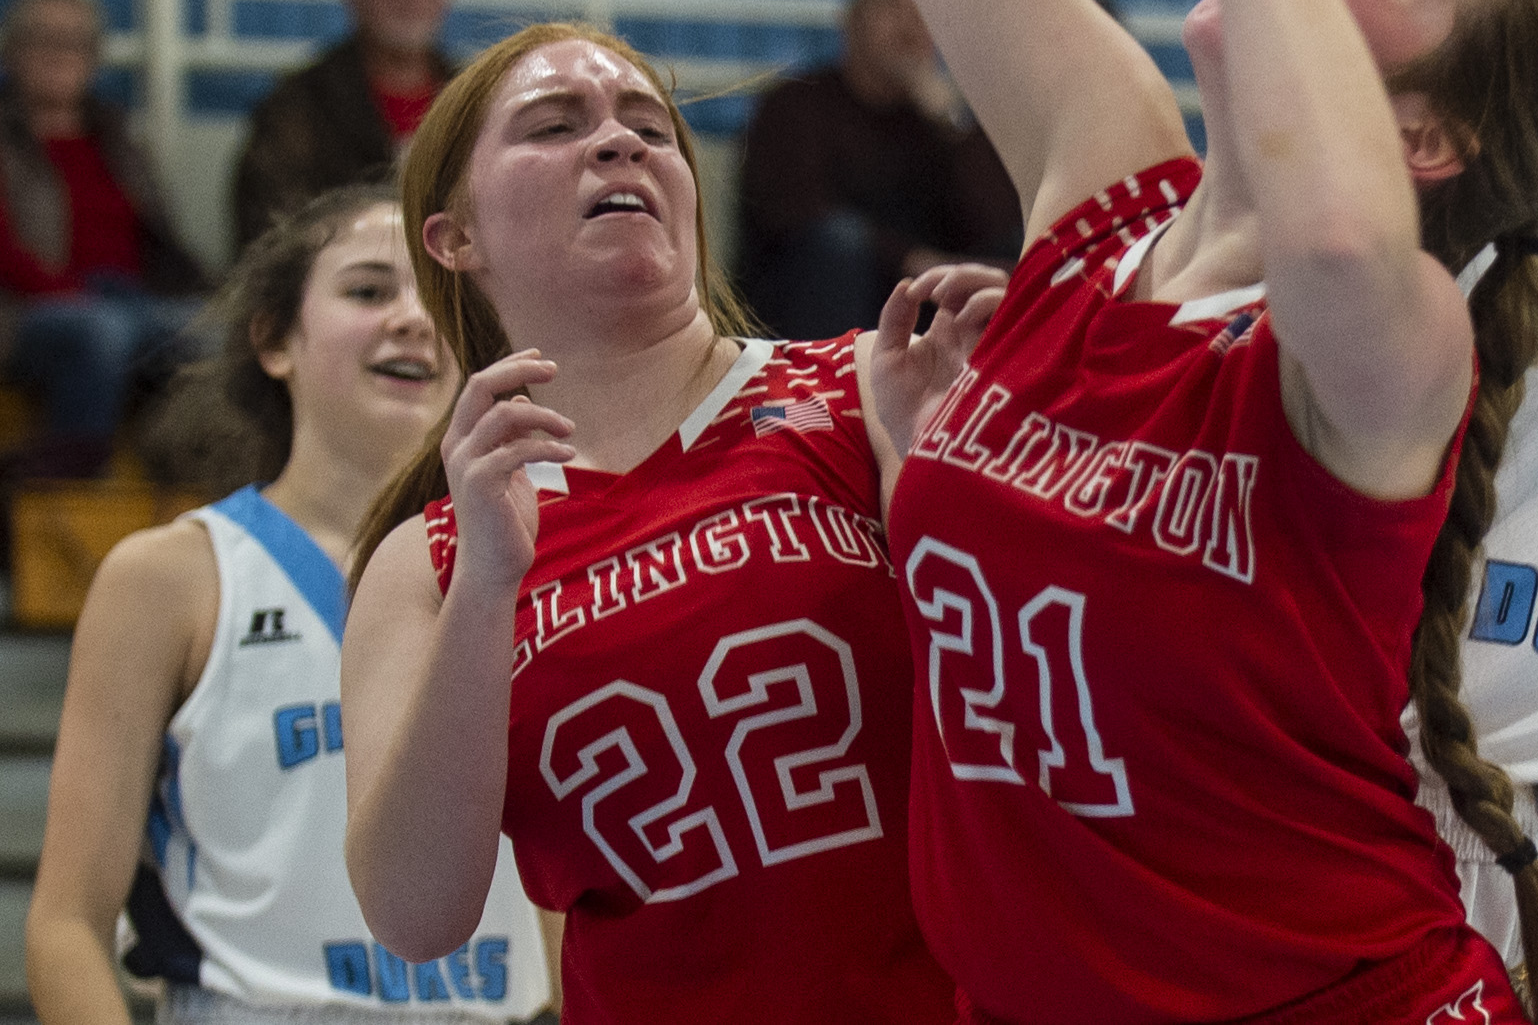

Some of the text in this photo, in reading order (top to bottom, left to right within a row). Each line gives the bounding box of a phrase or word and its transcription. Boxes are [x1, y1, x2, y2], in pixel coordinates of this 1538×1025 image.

[511, 492, 899, 680] LINGTO
[908, 362, 1258, 585] LLINGTON
[540, 617, 883, 904] 22
[905, 535, 1135, 818] 21
